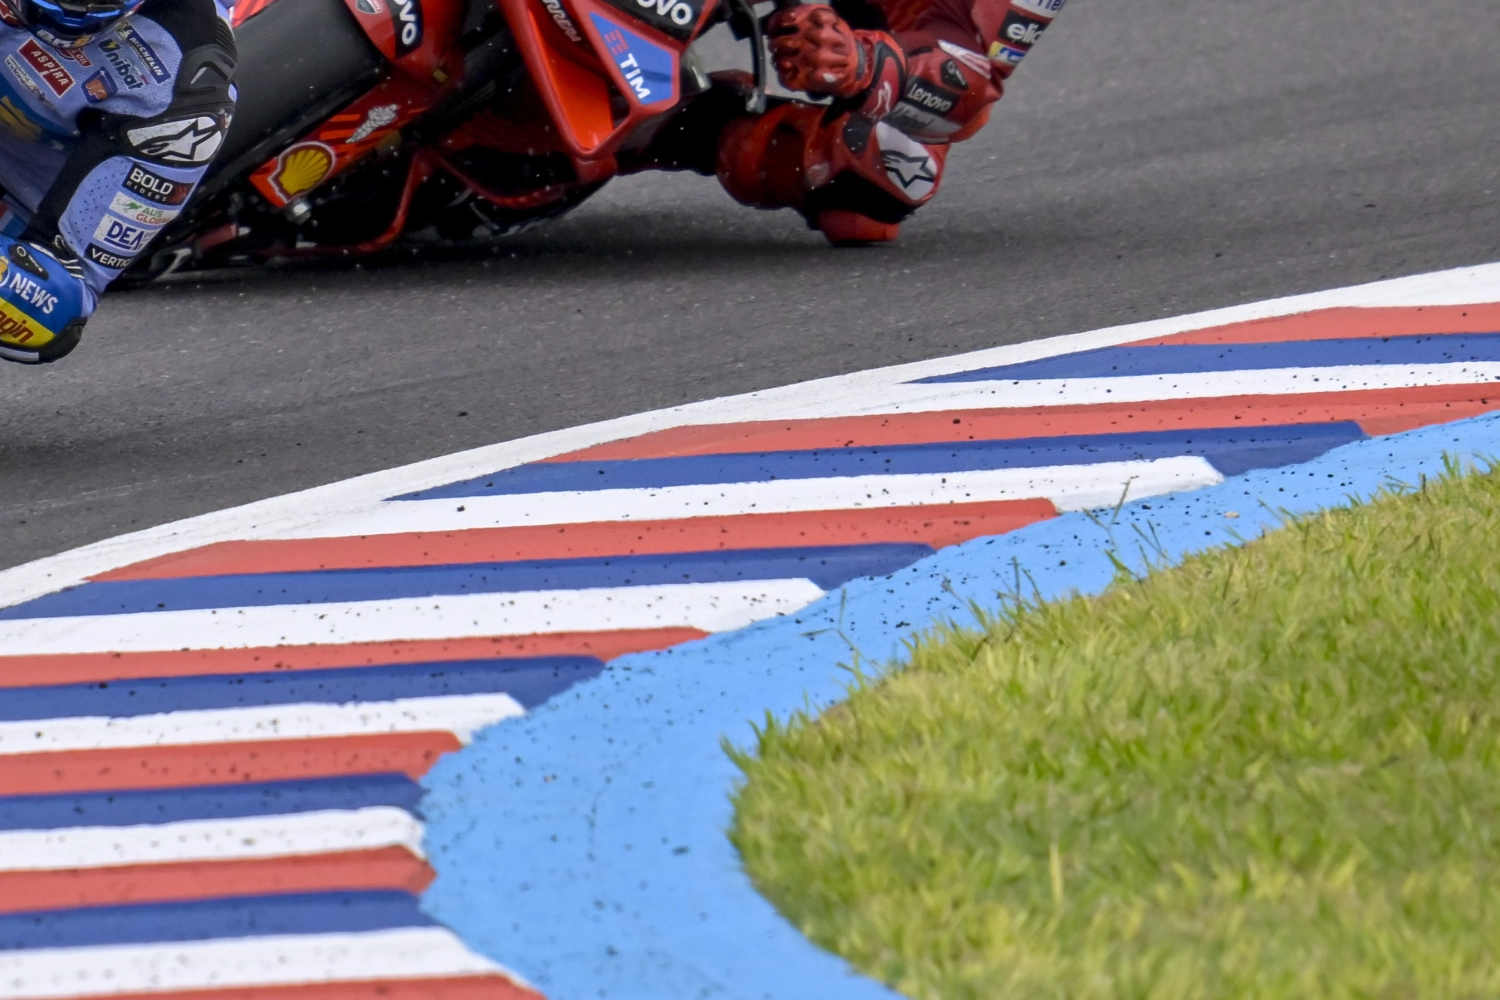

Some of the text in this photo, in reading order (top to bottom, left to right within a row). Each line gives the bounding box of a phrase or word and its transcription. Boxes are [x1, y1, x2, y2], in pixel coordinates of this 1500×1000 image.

[30, 49, 68, 88] ASPIRA
[98, 38, 145, 91] Unibat
[129, 35, 166, 78] MICHELIN
[619, 52, 652, 100] TIM
[907, 83, 953, 112] Lenovo
[126, 180, 167, 203] RIDERS
[129, 167, 174, 196] BOLD
[142, 206, 164, 218] AUS
[9, 273, 59, 315] NEWS
